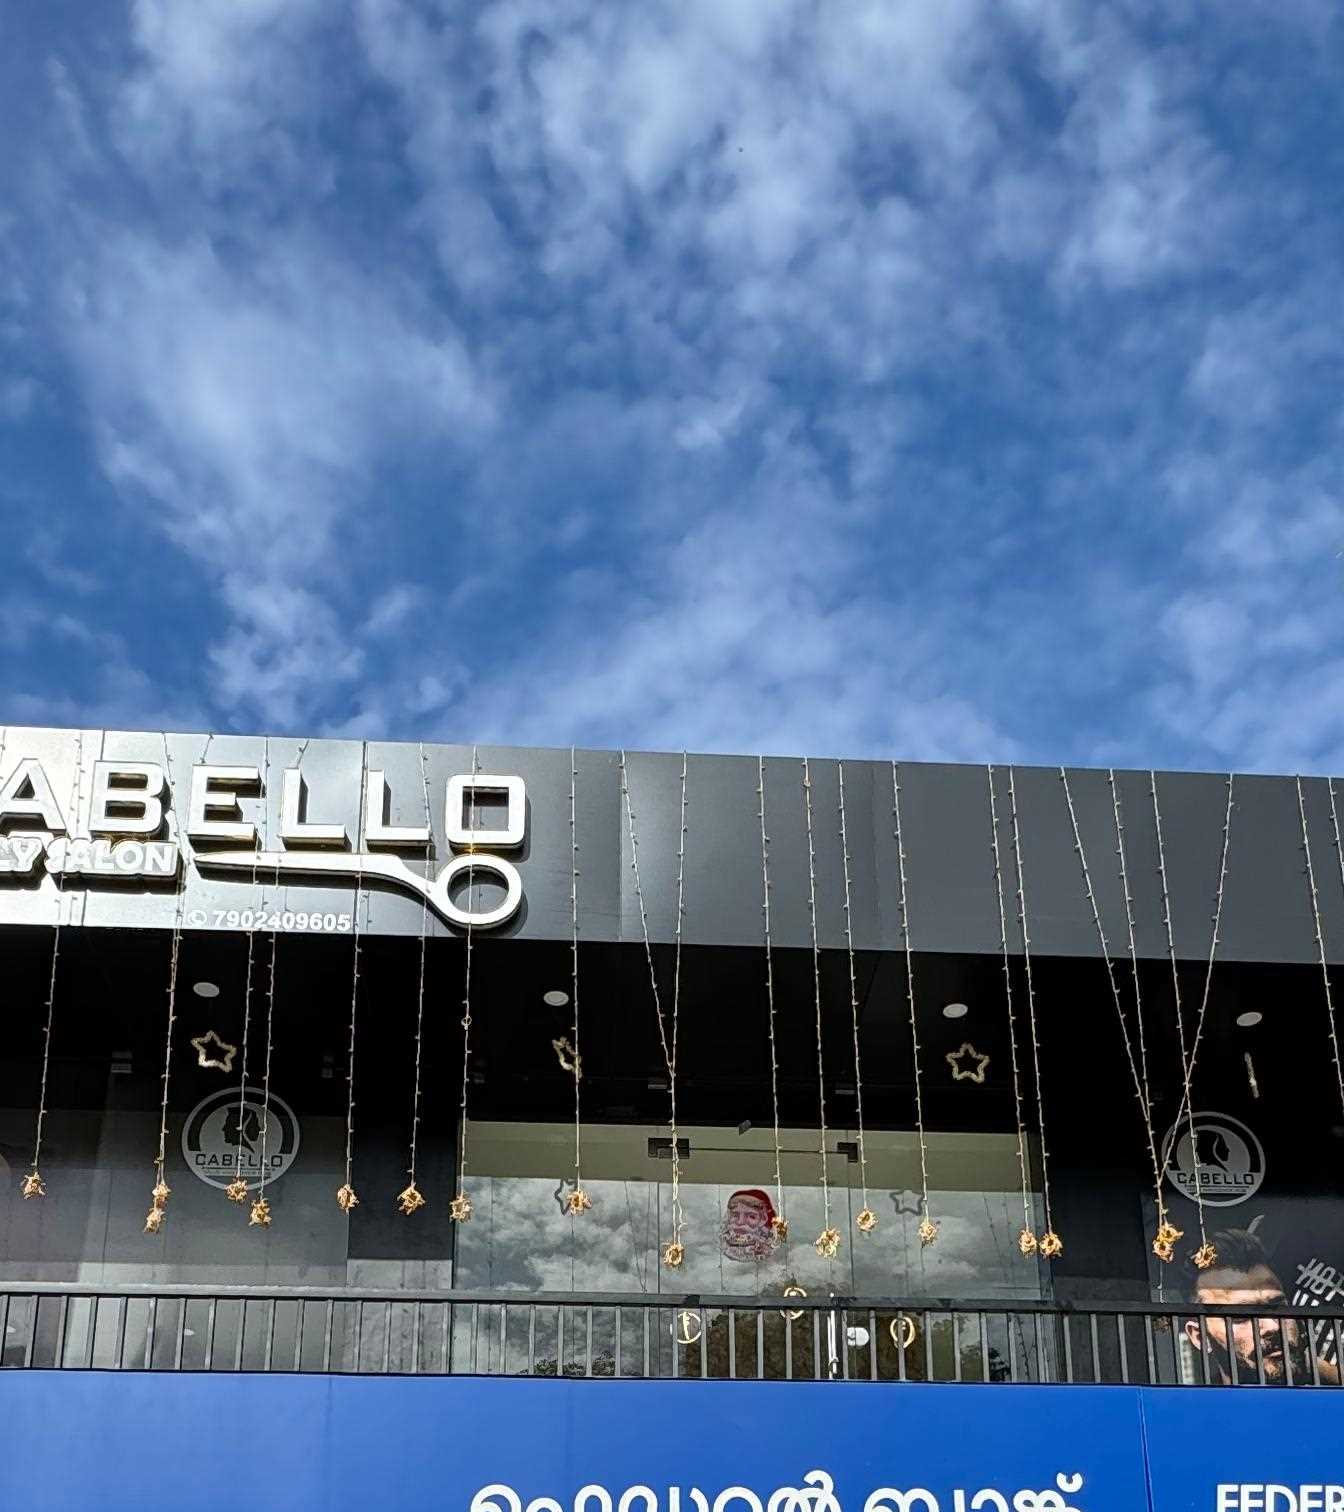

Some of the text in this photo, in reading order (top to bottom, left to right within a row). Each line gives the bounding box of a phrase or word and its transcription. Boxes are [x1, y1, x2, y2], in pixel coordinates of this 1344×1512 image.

[47, 839, 176, 874] SALON
[212, 909, 352, 932] 7902409605
[196, 1154, 282, 1168] CABELLO
[1177, 1173, 1254, 1185] CABELLO
